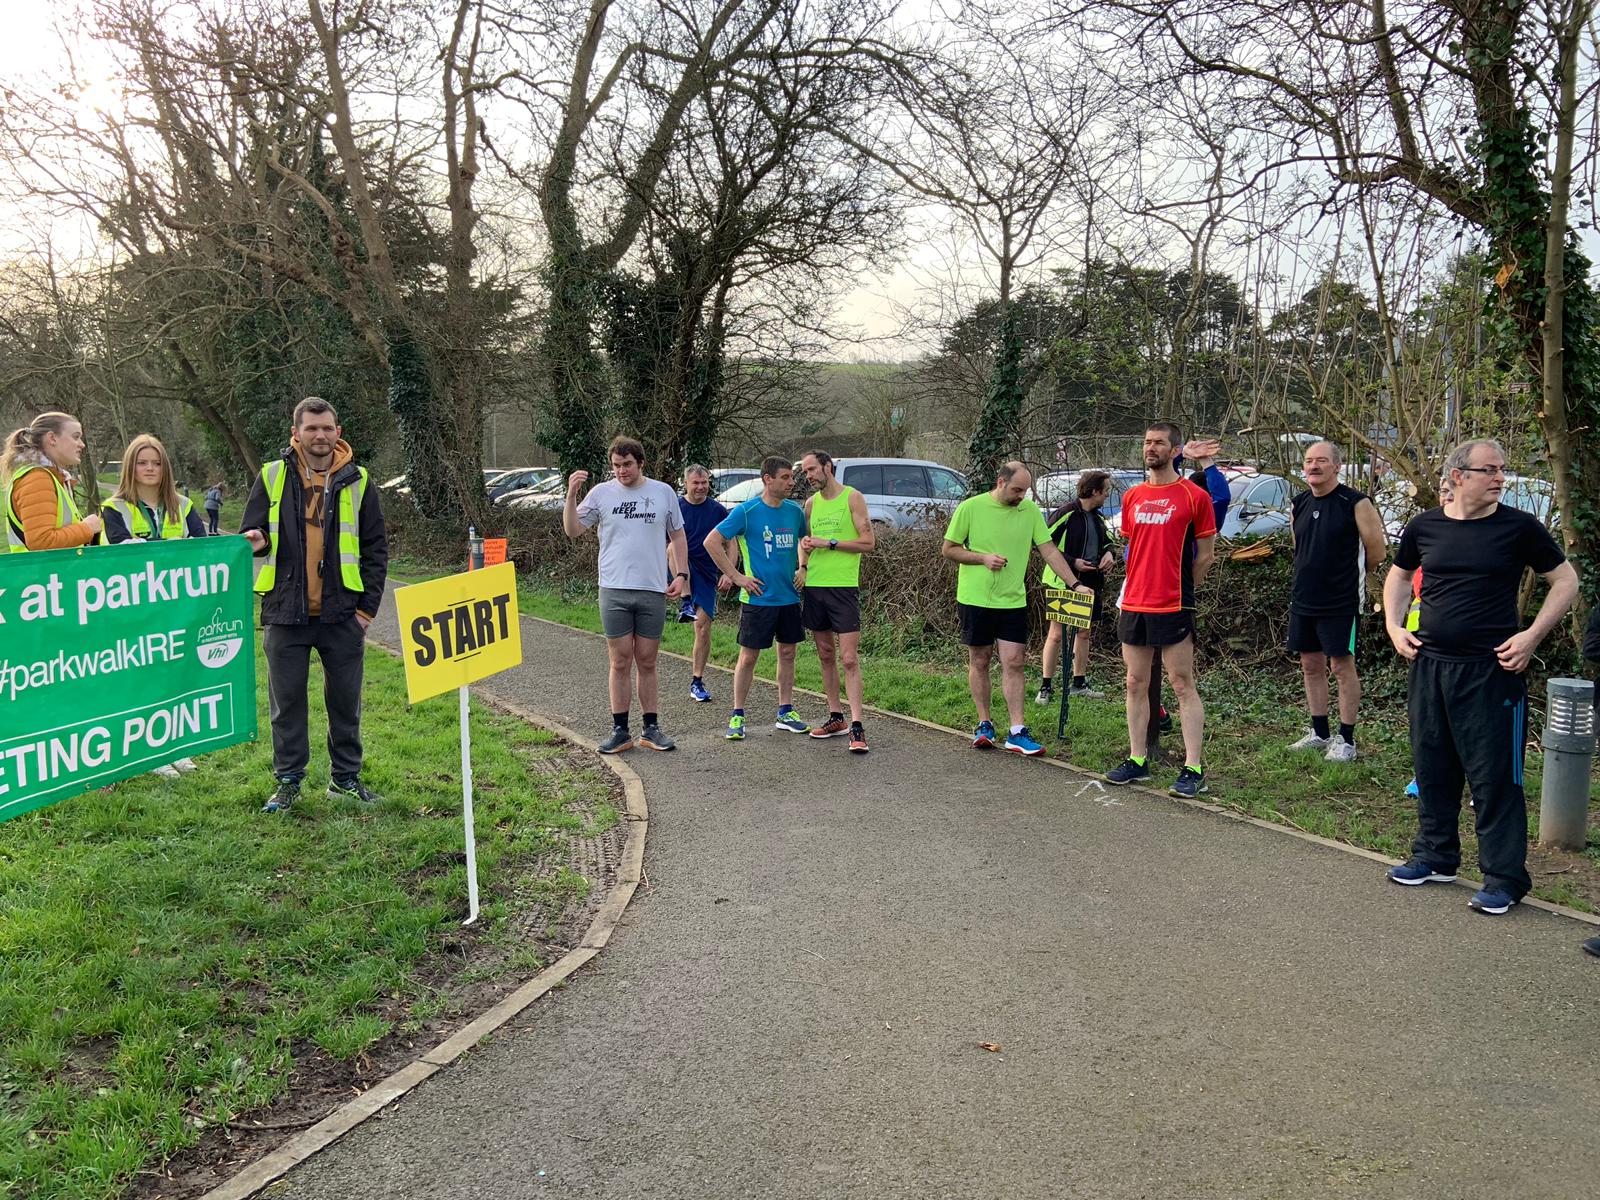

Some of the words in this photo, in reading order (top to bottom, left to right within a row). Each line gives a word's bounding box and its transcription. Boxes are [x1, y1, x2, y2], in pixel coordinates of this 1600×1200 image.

[612, 507, 637, 515] KEEP
[1135, 512, 1167, 525] RUN
[775, 534, 793, 545] RUN
[19, 573, 65, 621] at
[77, 561, 230, 625] parkrun
[197, 607, 243, 643] parkrun
[411, 593, 511, 667] START
[0, 629, 187, 700] #parkwalkIRE
[122, 693, 223, 756] POINT
